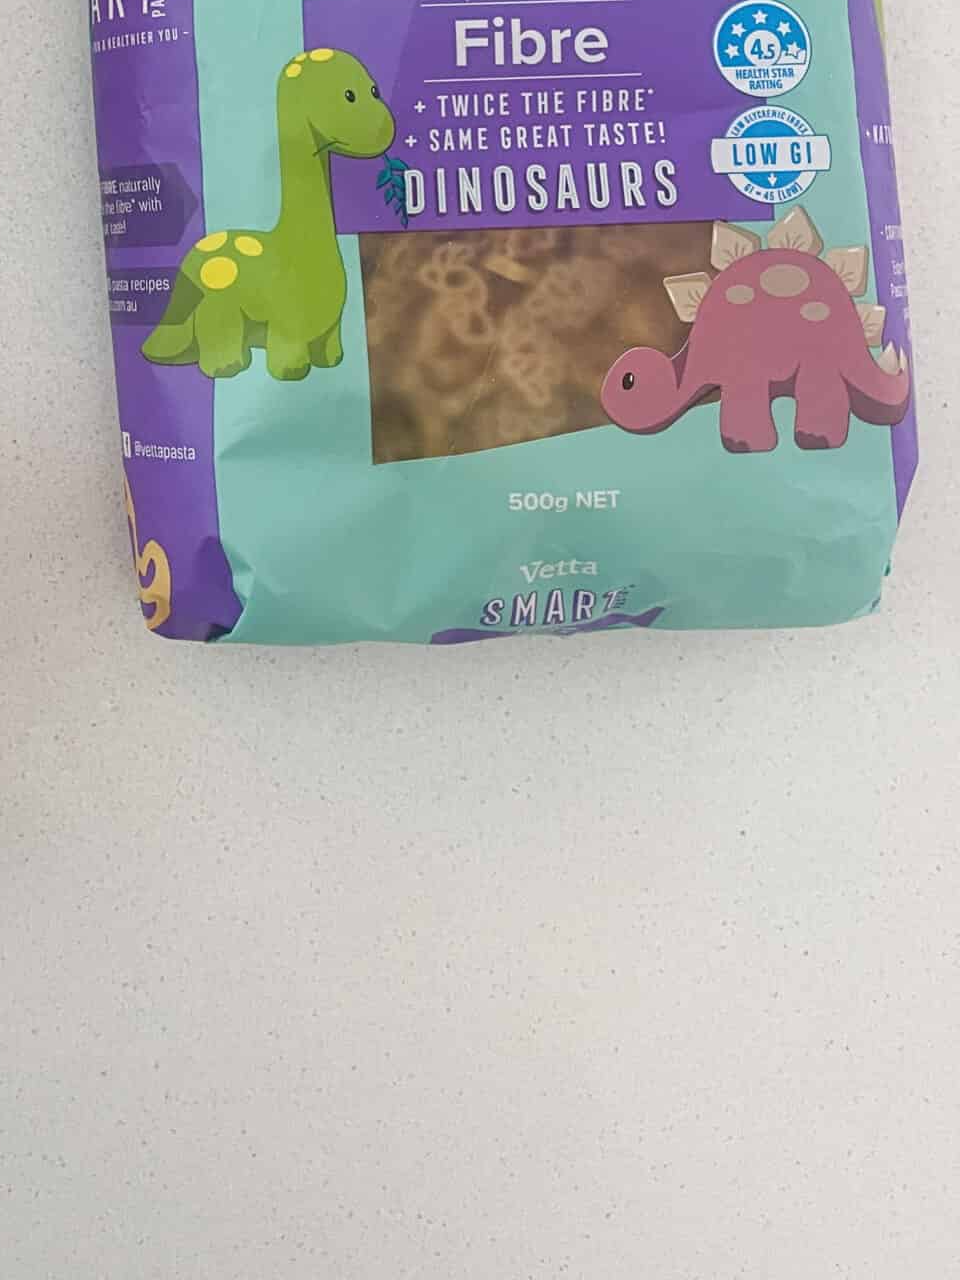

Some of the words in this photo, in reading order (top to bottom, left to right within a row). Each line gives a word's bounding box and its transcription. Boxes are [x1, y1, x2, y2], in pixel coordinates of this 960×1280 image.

[158, 27, 178, 42] YOU
[455, 16, 609, 67] Fibre
[736, 68, 770, 80] HEALTH
[771, 67, 794, 78] STAR
[749, 80, 783, 90] RATING
[437, 93, 510, 118] TWICE
[521, 91, 565, 115] THE
[429, 127, 489, 152] SAME
[500, 124, 572, 150] GREAT
[583, 121, 667, 147] TASTE!
[732, 143, 777, 167] LOW
[790, 141, 812, 165] GI
[119, 176, 161, 195] naturally
[403, 159, 679, 215] DINOSAURS
[138, 196, 162, 212] with
[130, 277, 170, 295] recipes
[508, 492, 569, 513] 500g
[575, 490, 621, 508] NET
[520, 558, 598, 584] Vetta
